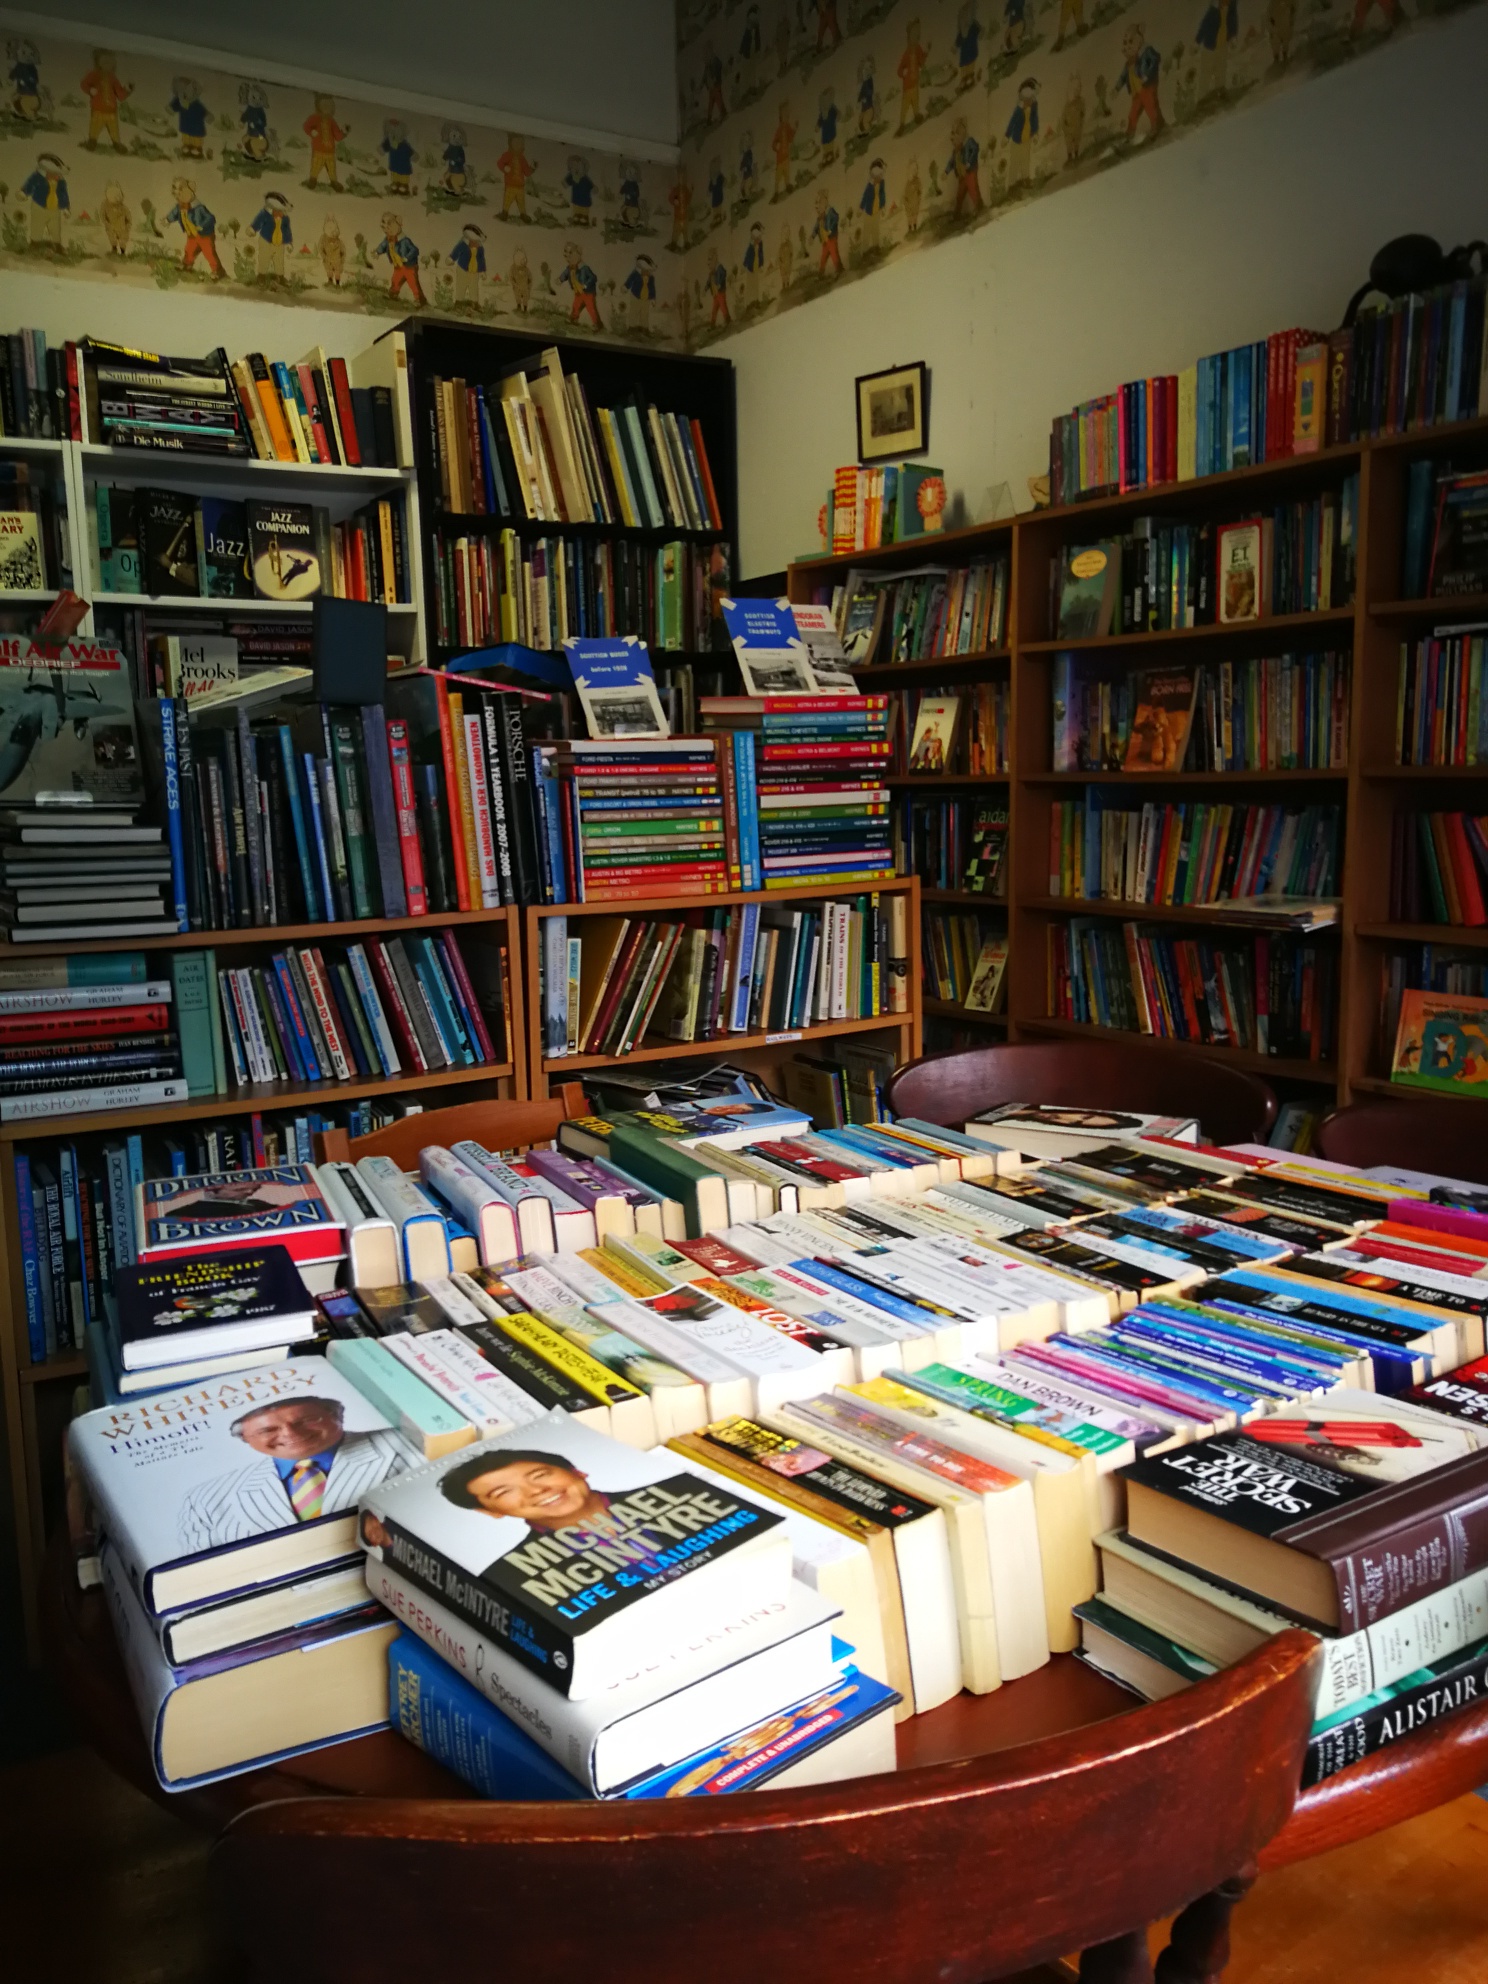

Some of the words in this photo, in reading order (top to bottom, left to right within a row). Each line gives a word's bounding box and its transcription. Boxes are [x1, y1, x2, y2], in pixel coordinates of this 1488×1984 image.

[106, 371, 162, 385] Sondheim
[133, 434, 151, 446] Die
[153, 436, 184, 449] Musik
[150, 507, 184, 520] JAZZ
[256, 521, 310, 535] COMPANION
[270, 511, 292, 523] JAZZ
[208, 533, 244, 557] Jazz
[9, 659, 81, 668] DEBRIEF
[68, 644, 118, 661] War
[161, 707, 175, 763] STRIKE
[484, 705, 498, 755] FORMULA
[469, 721, 485, 786] LOKOMOTIVEN
[509, 709, 527, 783] PORSCHE
[165, 766, 179, 810] ACES
[477, 788, 486, 806] DER
[491, 767, 506, 820] YEARBOOK
[480, 808, 493, 856] HANDBUCH
[496, 822, 511, 877] 2007-2008
[485, 857, 495, 877] DAS
[838, 912, 846, 940] TRAINS
[302, 953, 315, 973] WITH
[308, 973, 319, 988] THE
[88, 995, 123, 1004] HURLEY
[313, 988, 325, 1006] WIND
[319, 1007, 328, 1019] TO
[322, 1020, 333, 1034] THE
[326, 1034, 339, 1053] WEST
[13, 1096, 91, 1114] AIRSHOW
[104, 1087, 140, 1096] GRAHAM
[105, 1096, 139, 1106] HURLEY
[459, 1141, 496, 1167] RUSSELL
[491, 1166, 529, 1191] BRAND
[46, 1184, 59, 1203] THE
[62, 1169, 74, 1199] Airlift
[112, 1158, 126, 1212] DICTIONARY
[154, 1166, 302, 1199] DERREN
[48, 1203, 61, 1231] ROYAL
[117, 1215, 126, 1230] OF
[157, 1201, 322, 1243] BROWN
[49, 1231, 62, 1246] AIR
[118, 1232, 130, 1268] AVIATIO
[25, 1259, 37, 1287] Chaz
[51, 1247, 65, 1275] FORCE
[138, 1259, 266, 1286] FRIENDSHIP
[831, 1275, 865, 1294] GLASS
[25, 1288, 37, 1325] Bowyer
[749, 1306, 820, 1338] LOST
[98, 1373, 318, 1441] WHITELEY
[109, 1367, 298, 1425] RICHARD
[996, 1372, 1032, 1390] DAN
[1032, 1386, 1103, 1417] BROWN
[404, 1460, 450, 1483] NUMBER
[1162, 1454, 1313, 1515] SECRET
[1213, 1453, 1299, 1494] WAR
[1190, 1480, 1241, 1502] THE
[503, 1484, 694, 1578] MICHAEL
[520, 1491, 739, 1607] MCINTYRE
[556, 1582, 618, 1621] LIFE
[614, 1571, 645, 1589] &
[639, 1508, 760, 1576] LAUGHING
[642, 1574, 667, 1591] MY
[667, 1550, 714, 1579] STORY
[392, 1534, 444, 1591] MICHAEL
[445, 1572, 511, 1639] McINTYRE
[380, 1578, 406, 1617] SUE
[408, 1601, 468, 1670] PERKINS
[510, 1614, 528, 1633] LIFE
[509, 1629, 549, 1665] LAUGHING
[1326, 1644, 1347, 1708] TODAY'S
[1343, 1651, 1360, 1690] BEST
[490, 1671, 554, 1741] Spectacles
[1378, 1673, 1478, 1746] ALISTAIR
[715, 1754, 769, 1787] COMPLETE
[764, 1747, 778, 1759] &
[772, 1713, 835, 1753] UNABRIDGED
